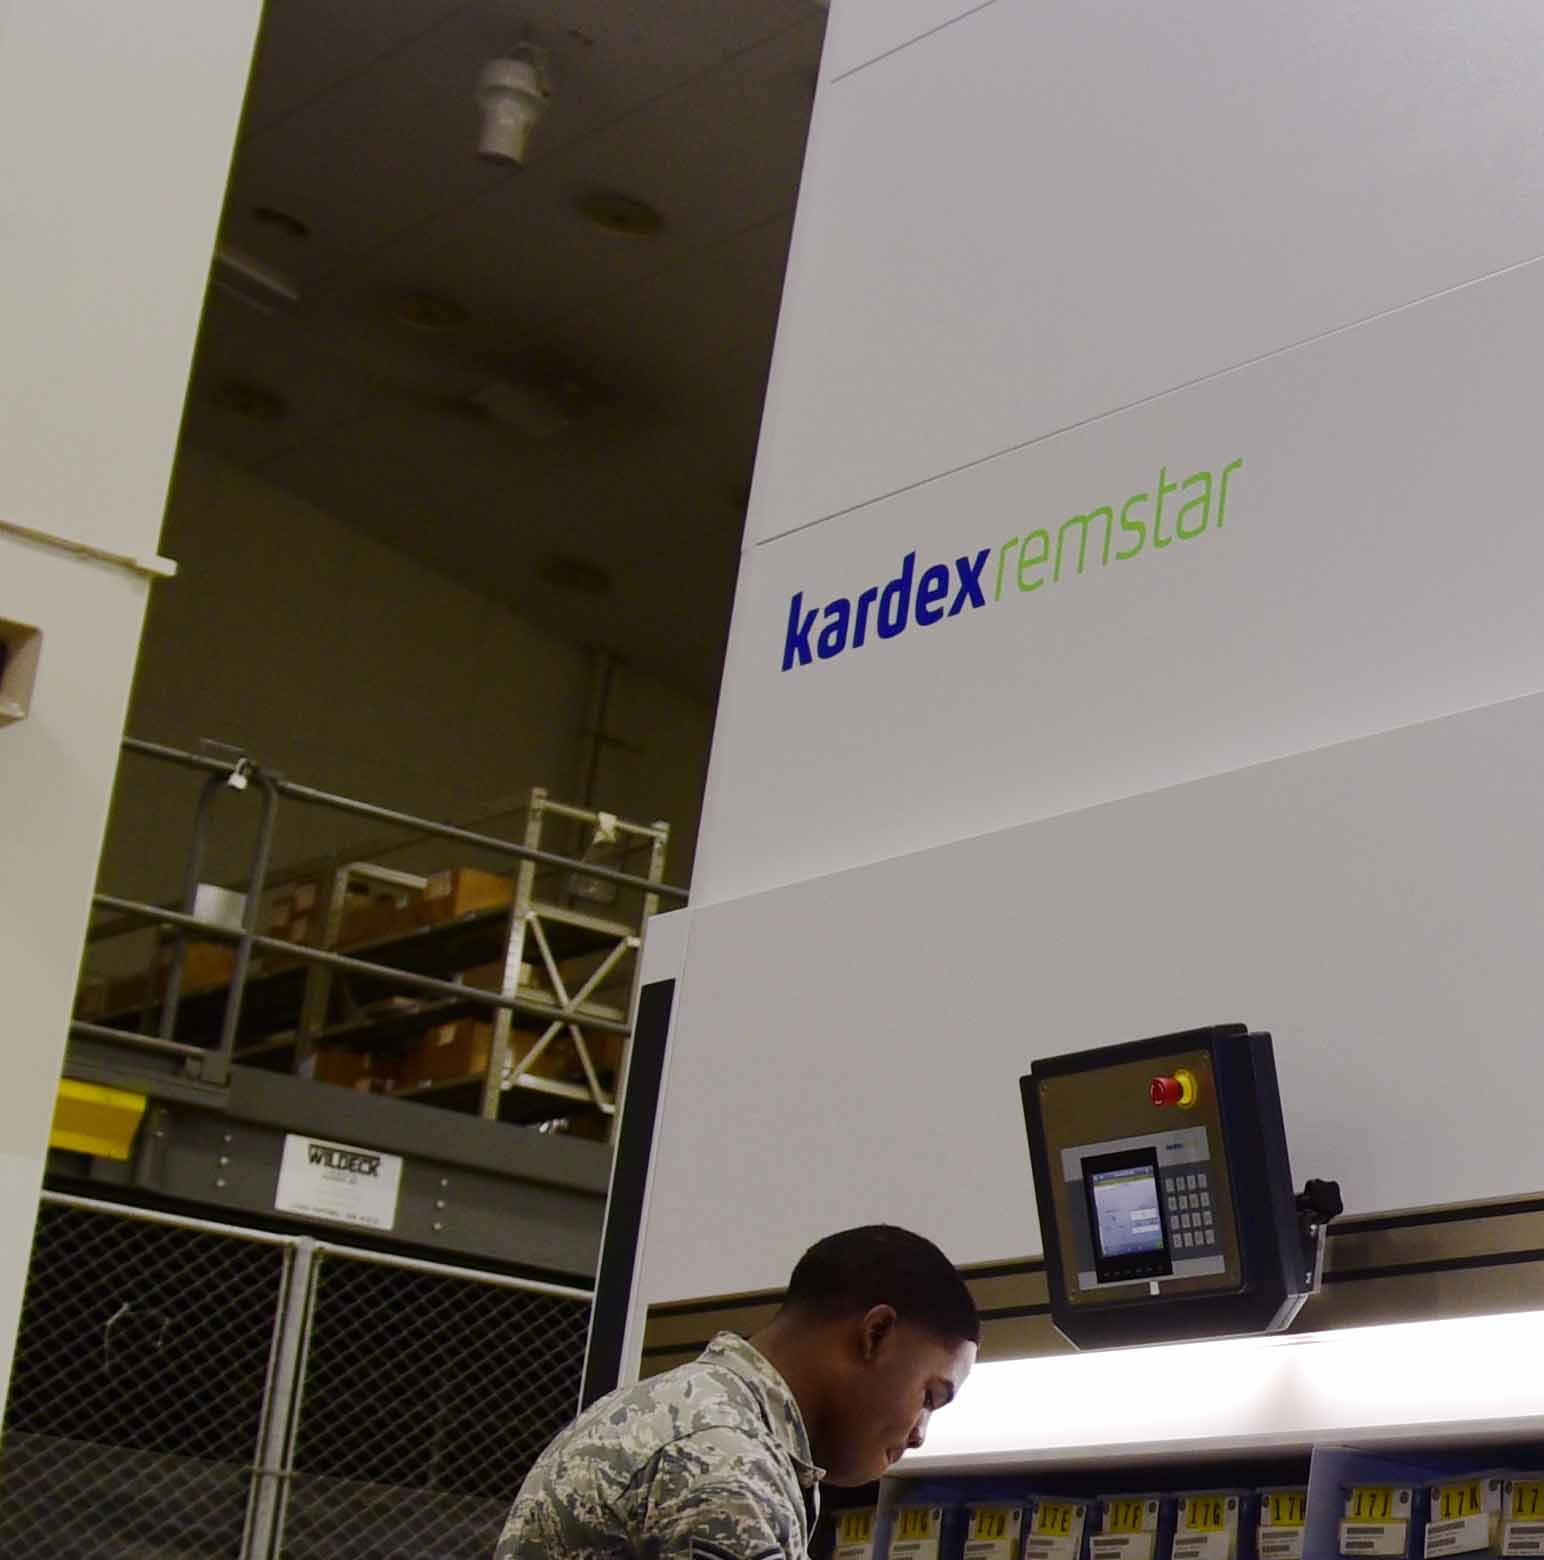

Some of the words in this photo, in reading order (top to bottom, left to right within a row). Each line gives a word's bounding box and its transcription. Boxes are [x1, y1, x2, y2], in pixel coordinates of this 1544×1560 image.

[308, 1143, 382, 1177] WILDECK
[1355, 1492, 1391, 1518] 17J
[1444, 1484, 1480, 1517] 17K
